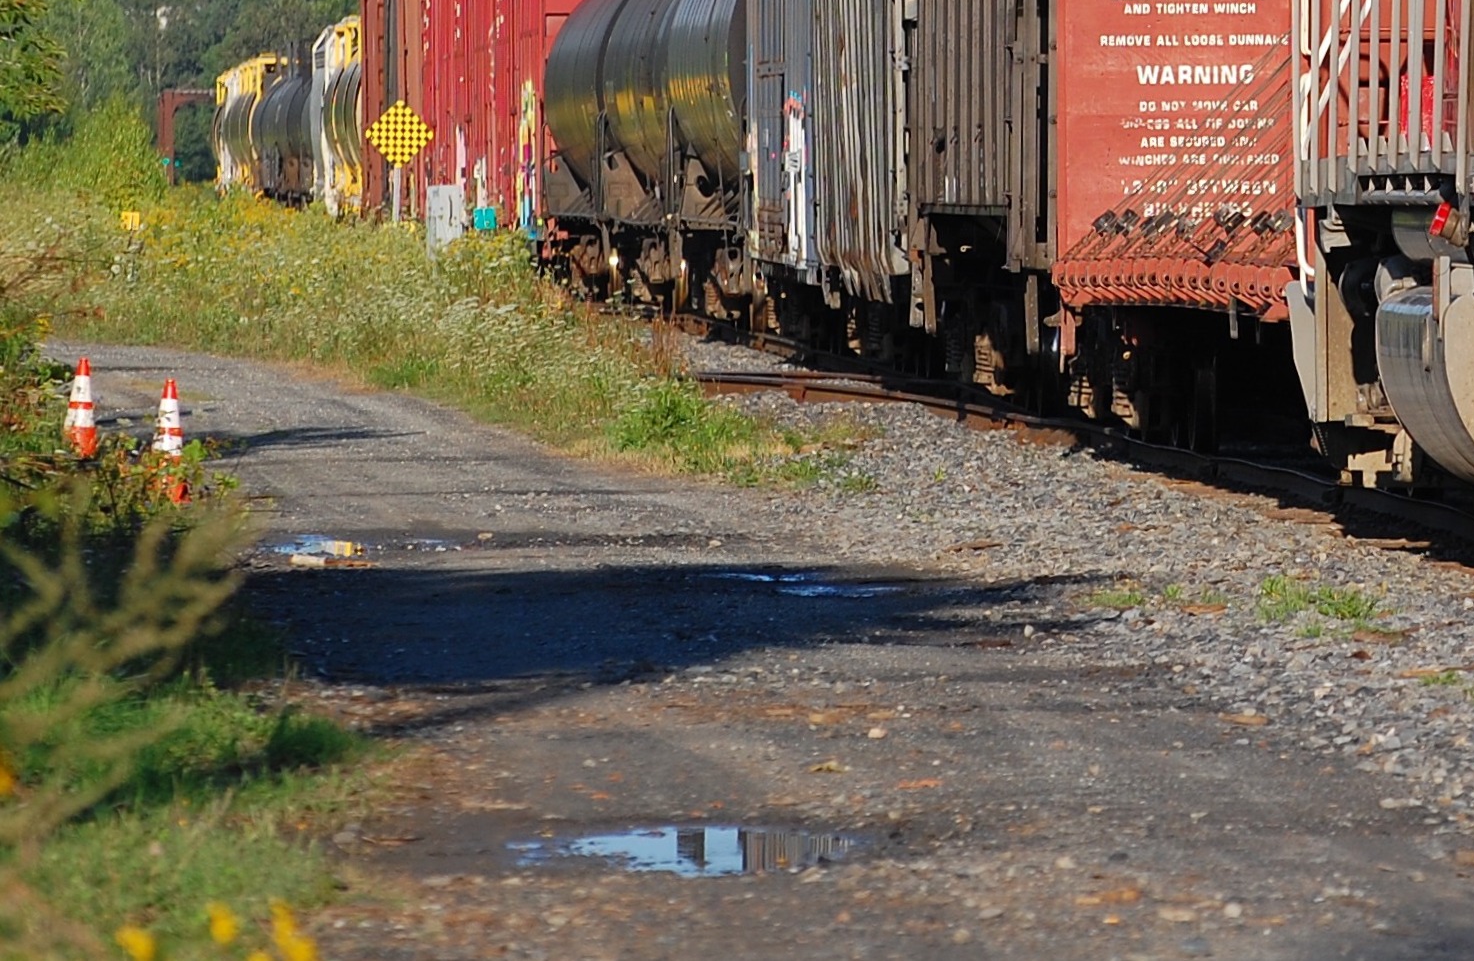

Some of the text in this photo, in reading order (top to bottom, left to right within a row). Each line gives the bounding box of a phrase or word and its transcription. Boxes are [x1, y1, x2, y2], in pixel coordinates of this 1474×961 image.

[1124, 2, 1257, 14] AND TIGHTEN WINCH
[1100, 34, 1151, 46] REMOVE
[1156, 34, 1179, 46] ALL
[1184, 34, 1224, 46] LOOSE
[1136, 65, 1255, 85] WARNING
[1139, 101, 1157, 112] DO
[1175, 118, 1198, 130] ALL
[1140, 136, 1165, 148] ARE
